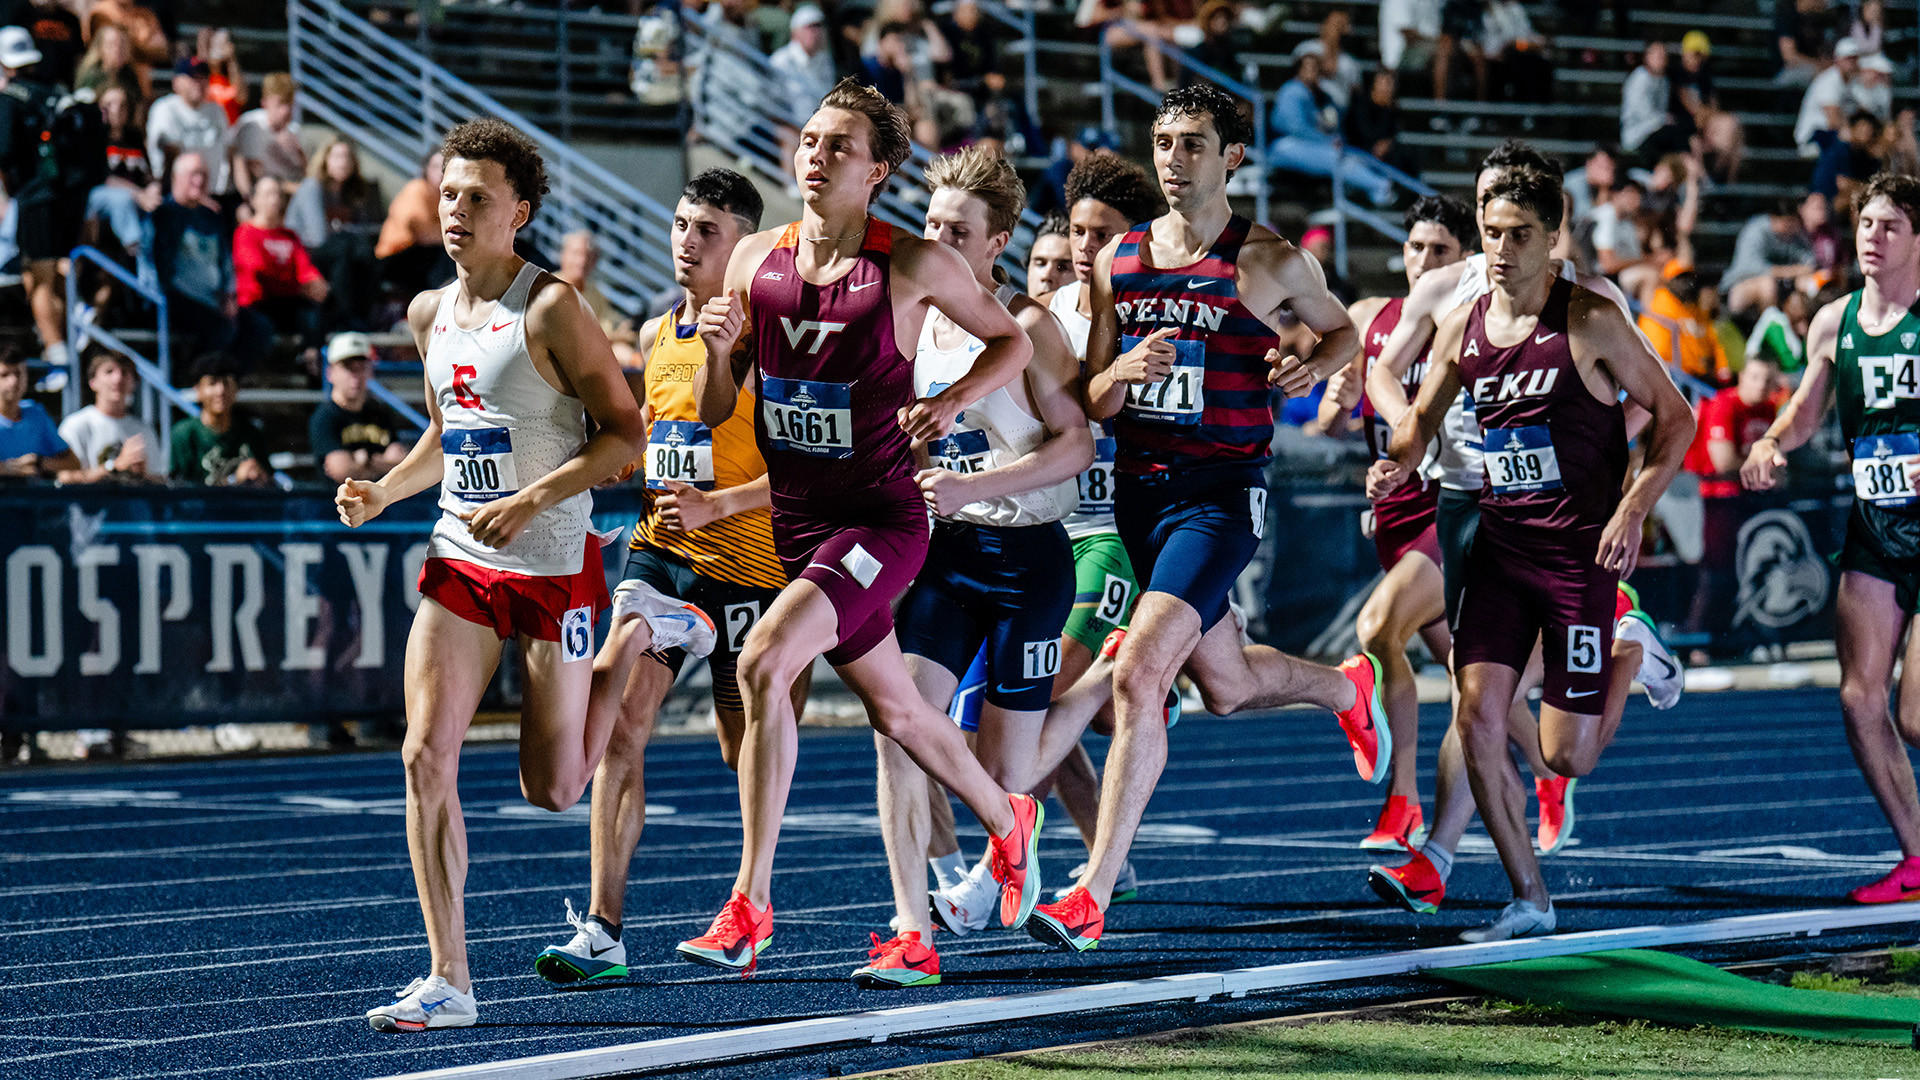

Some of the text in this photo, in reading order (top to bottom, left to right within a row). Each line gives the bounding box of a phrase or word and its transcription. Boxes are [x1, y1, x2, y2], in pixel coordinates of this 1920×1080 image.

[761, 271, 785, 281] ACC
[1115, 298, 1229, 332] PENN
[778, 315, 849, 355] VT
[1473, 368, 1559, 403] EKU
[1897, 359, 1918, 394] 4
[774, 407, 842, 445] 1661
[454, 458, 500, 491] 300
[656, 448, 698, 479] 804
[1498, 454, 1543, 482] 369
[1865, 462, 1910, 495] 381
[1103, 580, 1126, 619] 9
[566, 610, 589, 658] 6
[730, 606, 755, 648] 2
[1027, 641, 1058, 677] 10
[1572, 629, 1596, 669] 5
